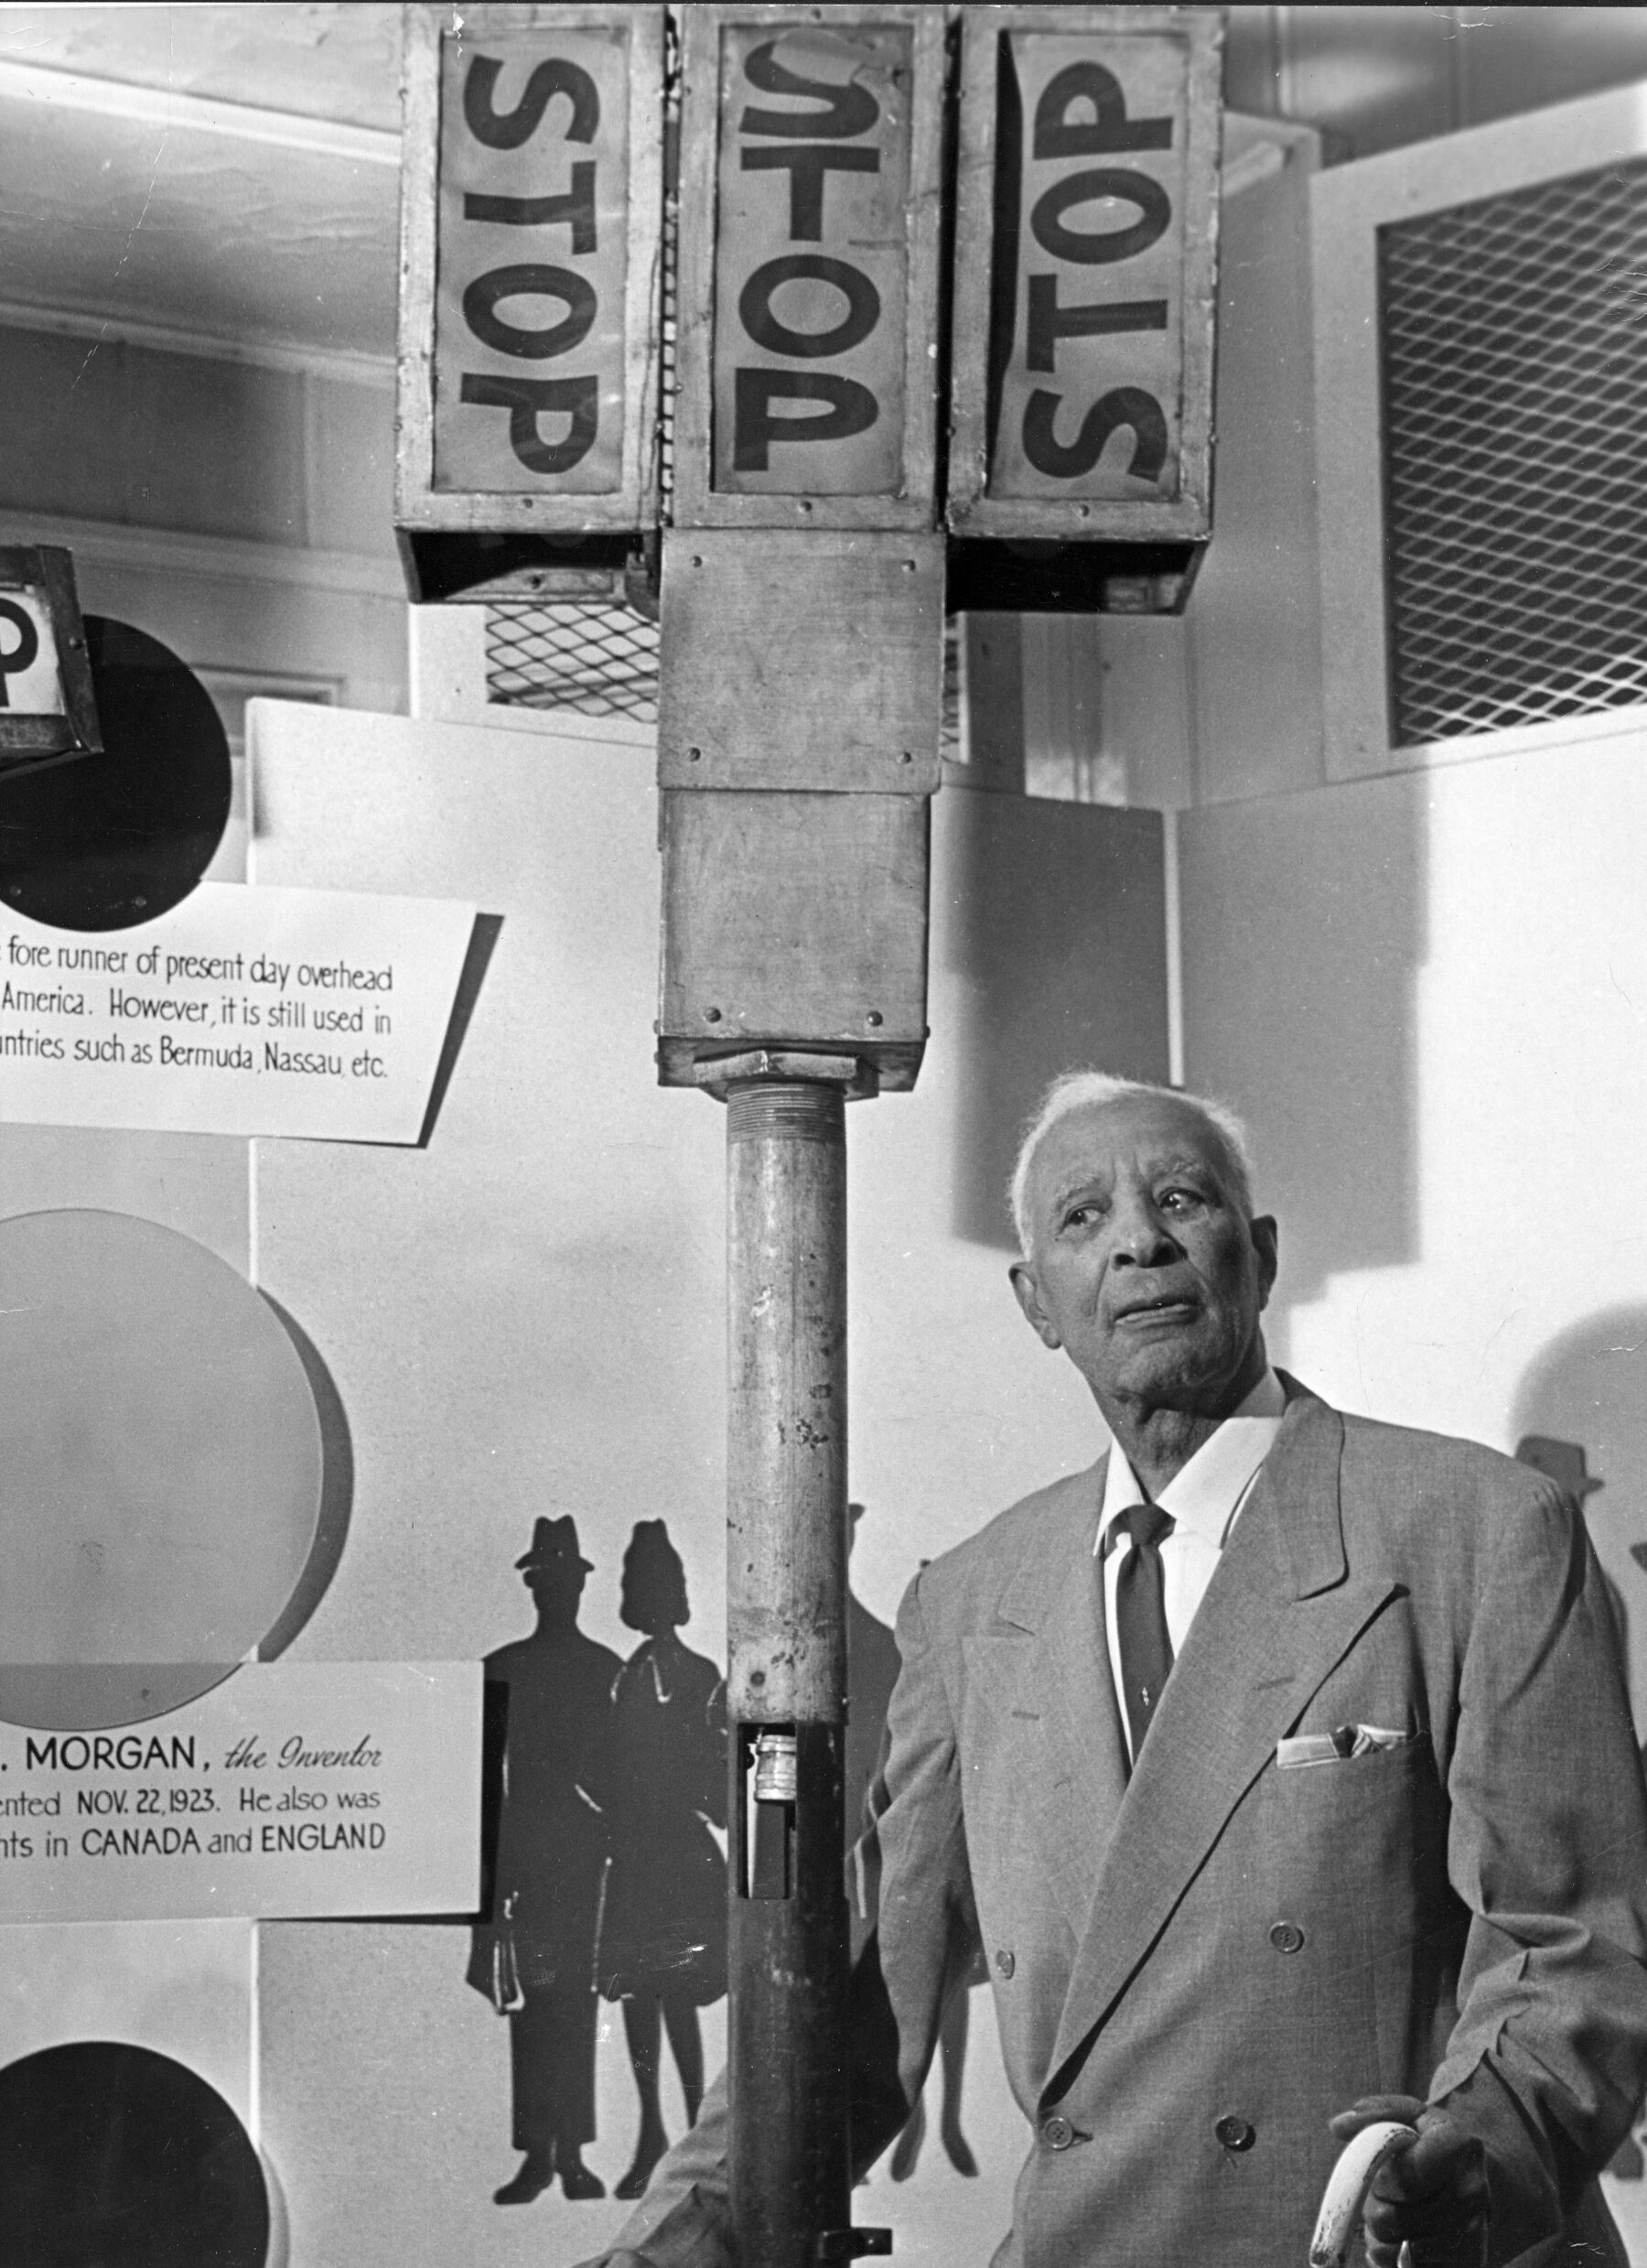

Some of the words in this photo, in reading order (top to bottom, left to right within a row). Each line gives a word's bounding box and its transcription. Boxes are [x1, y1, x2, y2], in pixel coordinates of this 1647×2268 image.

[460, 54, 600, 475] STOP
[733, 38, 880, 472] STOP
[1021, 59, 1174, 482] STOP
[7, 934, 52, 967] fore
[58, 947, 129, 974] runner
[135, 945, 161, 975] of
[166, 953, 244, 985] present
[250, 954, 291, 992] day
[296, 960, 393, 991] overhead
[1, 980, 93, 1016] America.
[109, 987, 216, 1027] However,
[221, 995, 237, 1024] it
[242, 996, 261, 1026] is
[267, 1000, 306, 1029] still
[313, 1006, 363, 1033] used
[374, 1004, 392, 1035] in
[73, 1032, 125, 1063] such
[130, 1043, 154, 1065] as
[351, 1049, 388, 1078] etc.
[26, 1734, 210, 1773] MORGAN,
[224, 1734, 267, 1769] the
[277, 1733, 382, 1770] Inventor
[77, 1789, 129, 1816] NOV.
[239, 1787, 273, 1812] He
[275, 1785, 328, 1812] also
[336, 1791, 381, 1809] was
[45, 1830, 69, 1858] in
[81, 1827, 201, 1857] CANADA
[207, 1827, 253, 1855] and
[261, 1822, 386, 1853] ENGLAND
